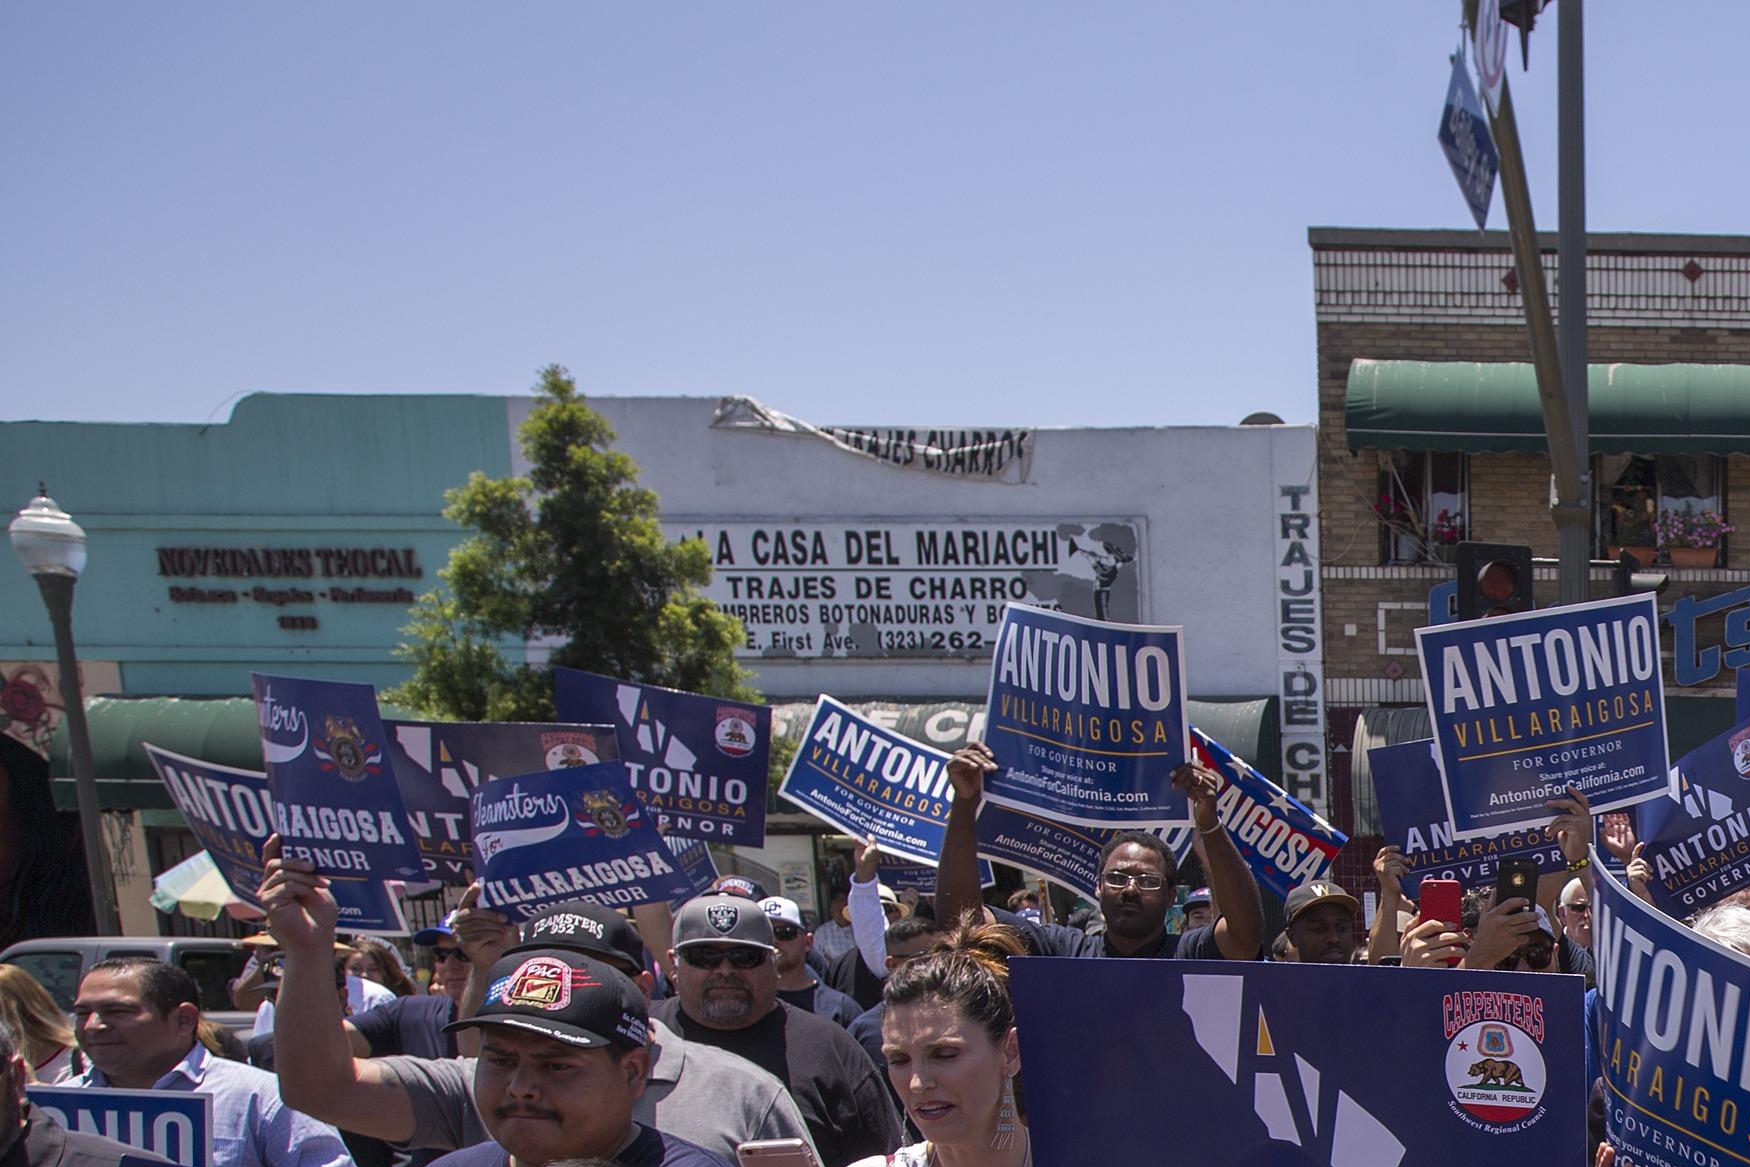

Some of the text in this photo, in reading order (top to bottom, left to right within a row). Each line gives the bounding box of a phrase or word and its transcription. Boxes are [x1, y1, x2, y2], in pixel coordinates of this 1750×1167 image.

[751, 530, 829, 566] CASA
[845, 530, 900, 566] DEL
[916, 529, 1059, 567] MARIACHI
[1280, 485, 1316, 653] TRAJES
[727, 576, 1028, 601] TRAJES DE CHARRO
[819, 604, 954, 625] BOTONADURAS
[964, 604, 977, 625] Y
[771, 631, 813, 650] First
[823, 632, 860, 650] Ave.
[878, 630, 926, 651] (323)
[1000, 622, 1172, 712] ANTONIO
[1443, 615, 1653, 714] ANTONIO
[1284, 671, 1318, 726] DE
[1001, 693, 1168, 744] VILLARAIGOSA
[1453, 689, 1655, 748] VILLARAIGOSA
[814, 711, 955, 803] ANTONI
[1028, 744, 1117, 773] FOR GOVERNOR
[1513, 740, 1624, 771] FOR GOVERNOR
[1539, 764, 1597, 783] Share voice
[624, 761, 748, 805] TONIO
[1006, 767, 1149, 803] AntonioForCalifornia.com
[1488, 763, 1645, 807] AntonioForCalifornia.com
[473, 782, 560, 828] Teamsters
[810, 788, 927, 848] AntonioForCalifornia.com
[834, 784, 916, 827] FOR GOVERNOR
[1026, 821, 1051, 837] FOR
[1483, 853, 1498, 863] FOR
[532, 912, 605, 941] TEAMSTERS
[549, 924, 576, 936] 952
[526, 965, 563, 979] PAC
[1443, 991, 1545, 1044] CARPENTERS
[1457, 1091, 1536, 1105] CALIFORNIA REPUBLIC
[1447, 1100, 1546, 1135] Southwest Regional Council
[1621, 1138, 1645, 1161] your
